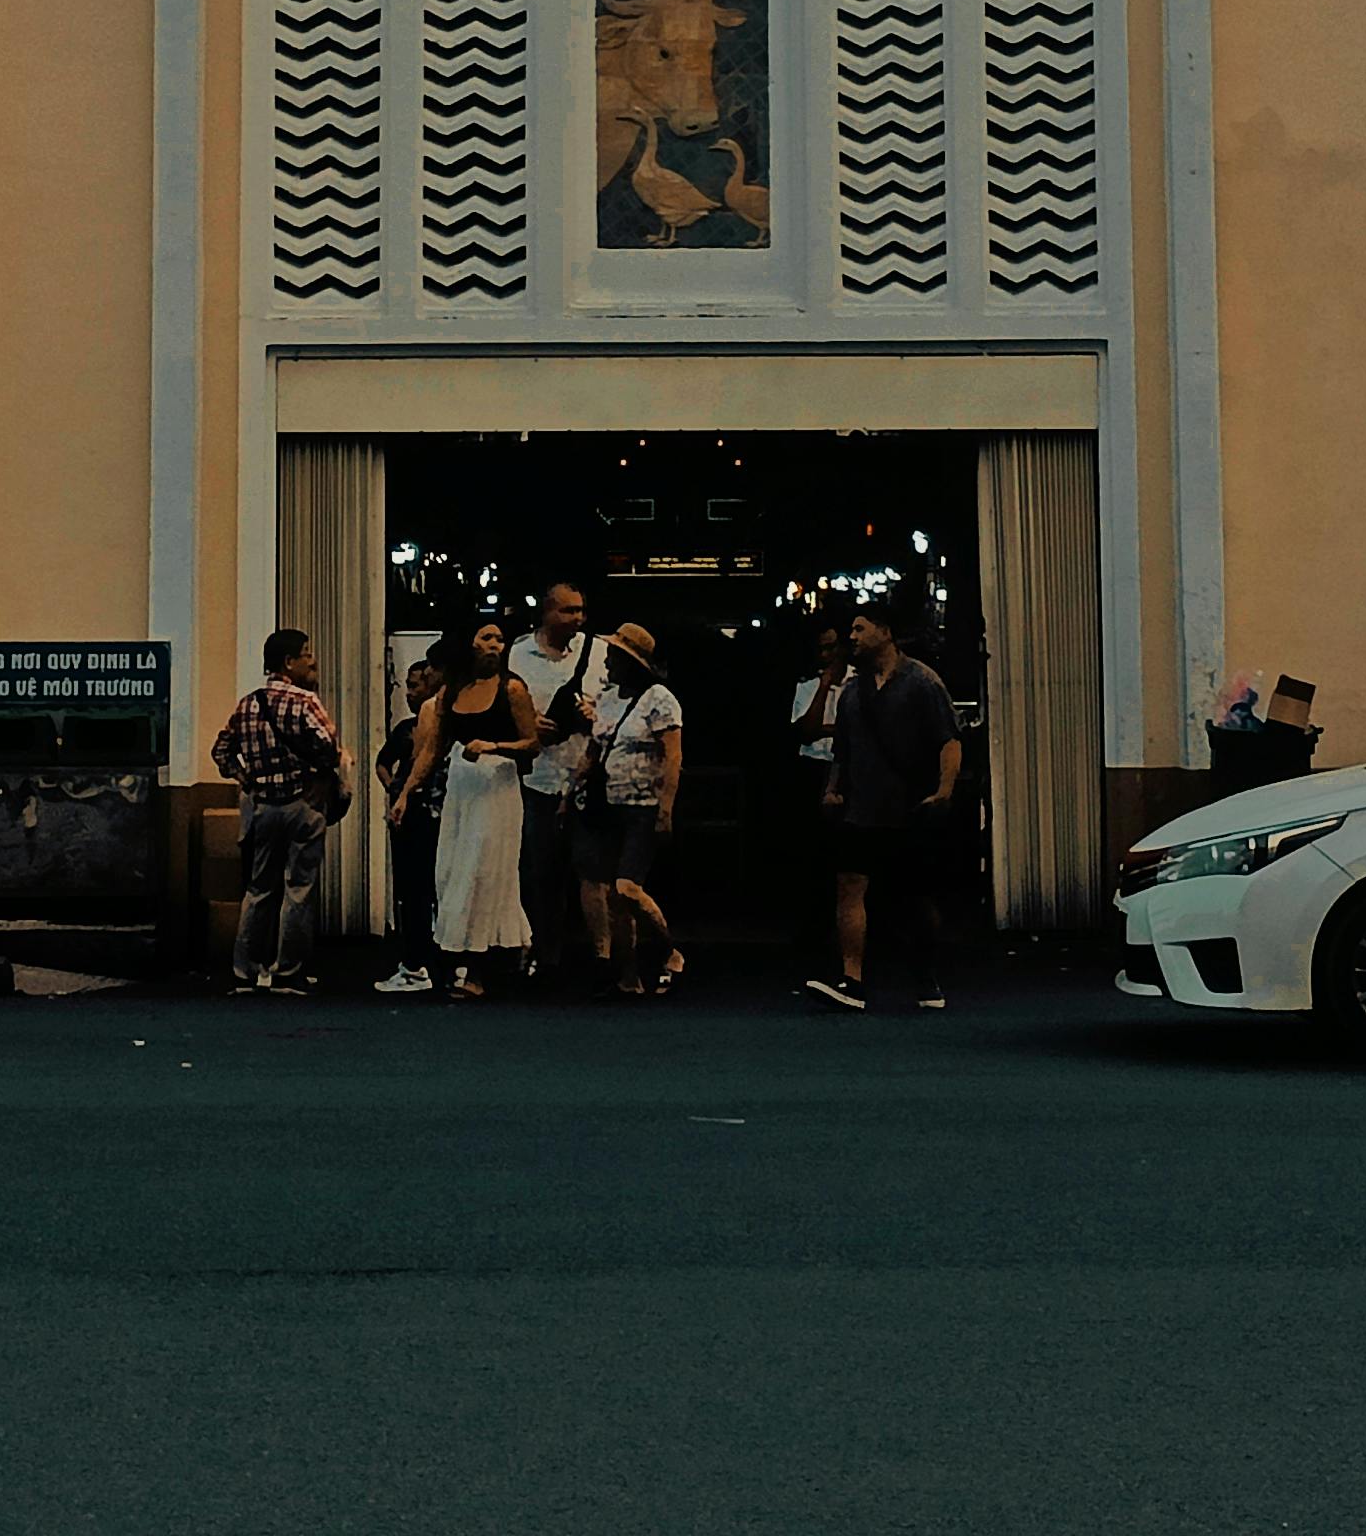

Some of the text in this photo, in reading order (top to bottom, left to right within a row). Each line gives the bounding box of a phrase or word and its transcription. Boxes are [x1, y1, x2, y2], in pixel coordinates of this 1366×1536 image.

[11, 652, 41, 670] NƠI
[47, 654, 82, 670] QUY
[136, 650, 157, 670] LÀ
[16, 677, 37, 699] VỆ
[43, 677, 79, 697] MÔI
[85, 677, 155, 697] TRƯỜNG
